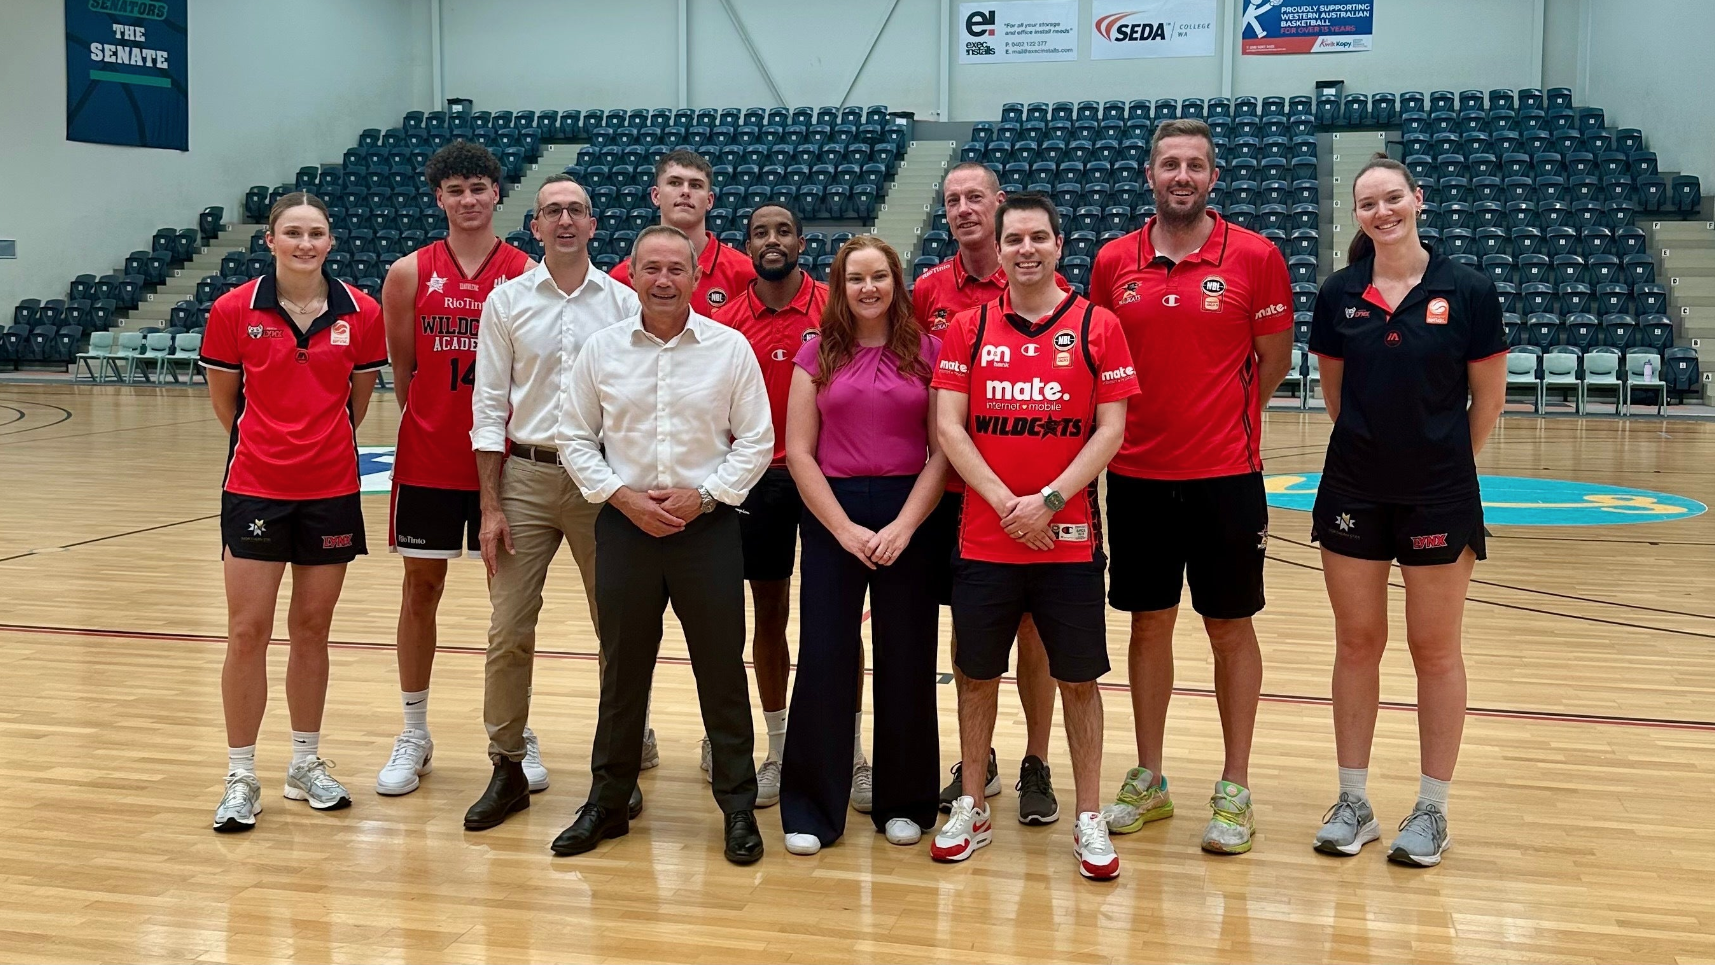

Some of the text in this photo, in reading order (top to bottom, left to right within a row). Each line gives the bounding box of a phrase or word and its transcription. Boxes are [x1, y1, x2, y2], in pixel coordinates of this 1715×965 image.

[89, 0, 166, 18] SENATORS
[1281, 3, 1370, 13] PROUDLY SUPPORTING
[1280, 12, 1319, 20] WESTERN
[1179, 22, 1211, 30] COLLEGE
[1280, 19, 1331, 28] BASKETBALL
[112, 23, 146, 42] THE
[1114, 22, 1166, 42] SEDA
[966, 41, 988, 49] exec
[90, 42, 169, 69] SENATE
[1206, 281, 1221, 292] NBL
[711, 292, 723, 303] NBL
[1058, 335, 1072, 345] NBL
[986, 377, 1070, 401] mate.
[986, 401, 1062, 411] internet mobile
[321, 533, 353, 549] LYNX
[1410, 532, 1448, 550] LYNX
